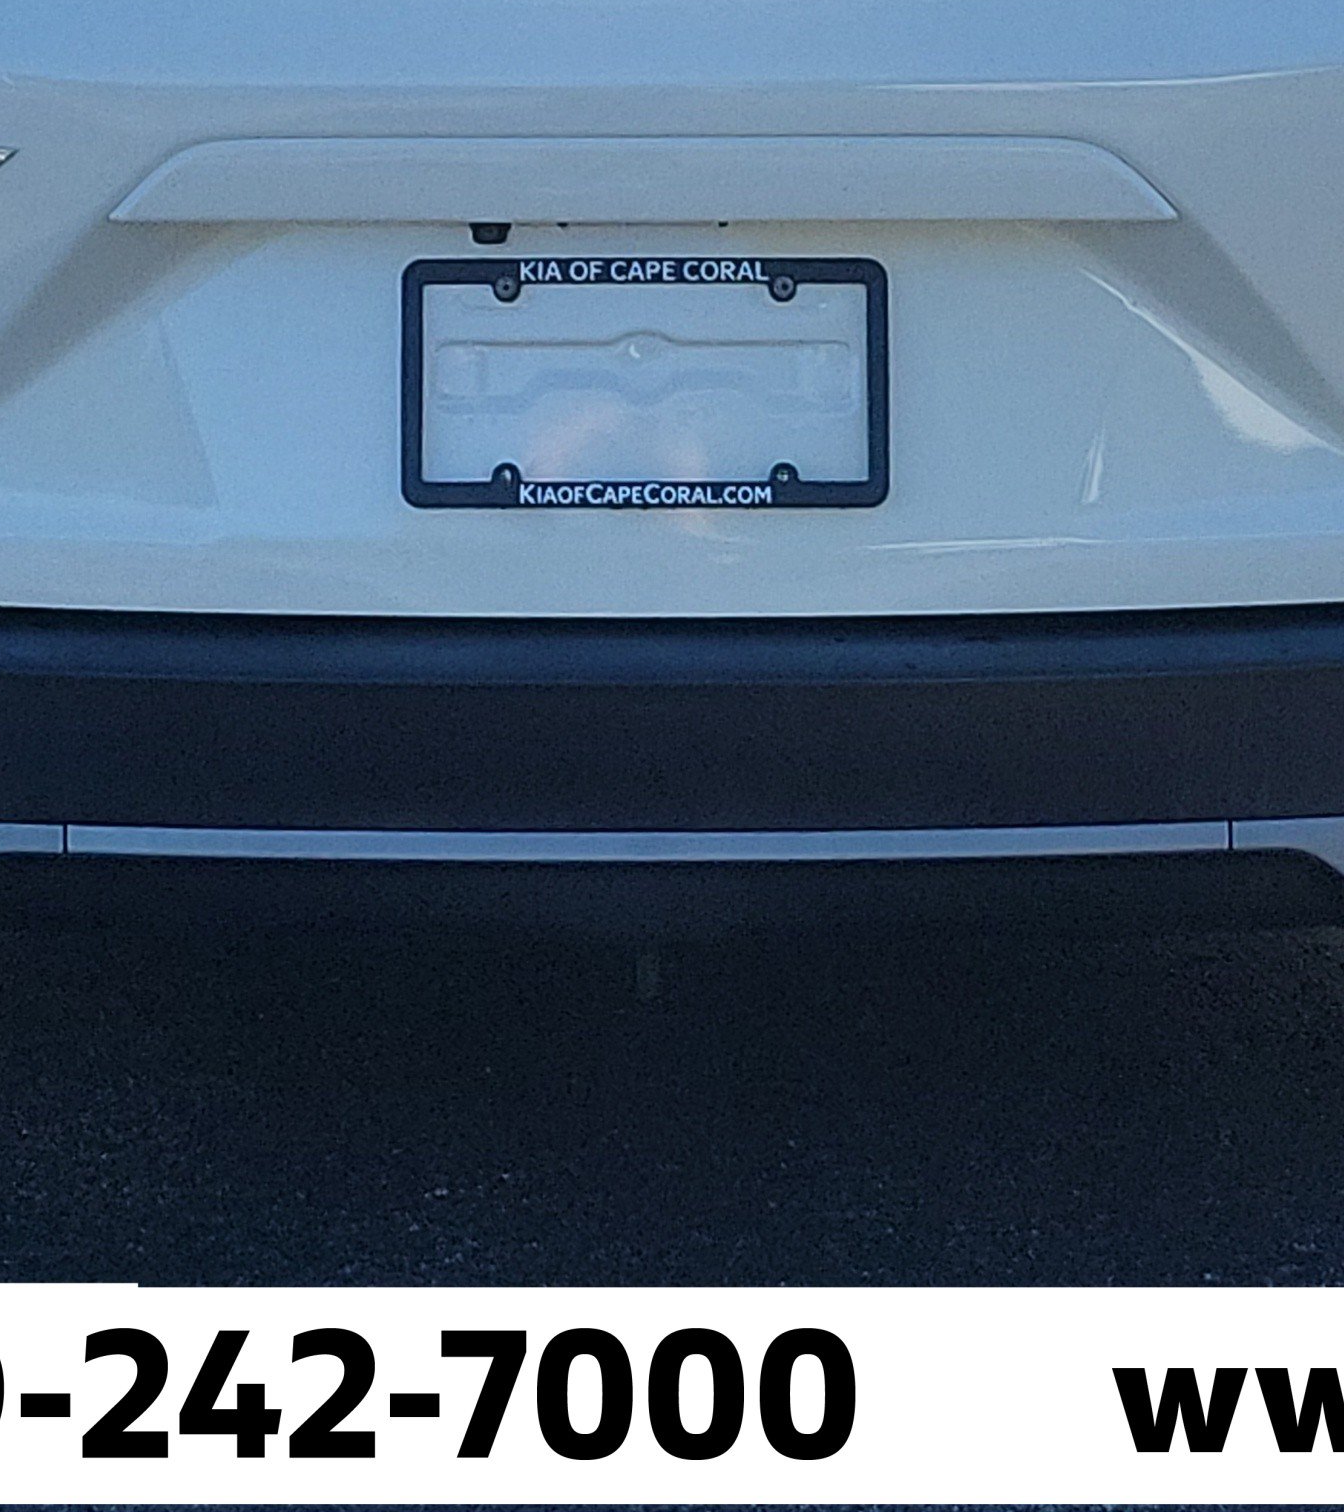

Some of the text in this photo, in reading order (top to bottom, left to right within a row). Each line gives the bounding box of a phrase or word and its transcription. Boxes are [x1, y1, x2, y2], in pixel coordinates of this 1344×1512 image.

[519, 261, 769, 282] KIA OF CAPE CORAL
